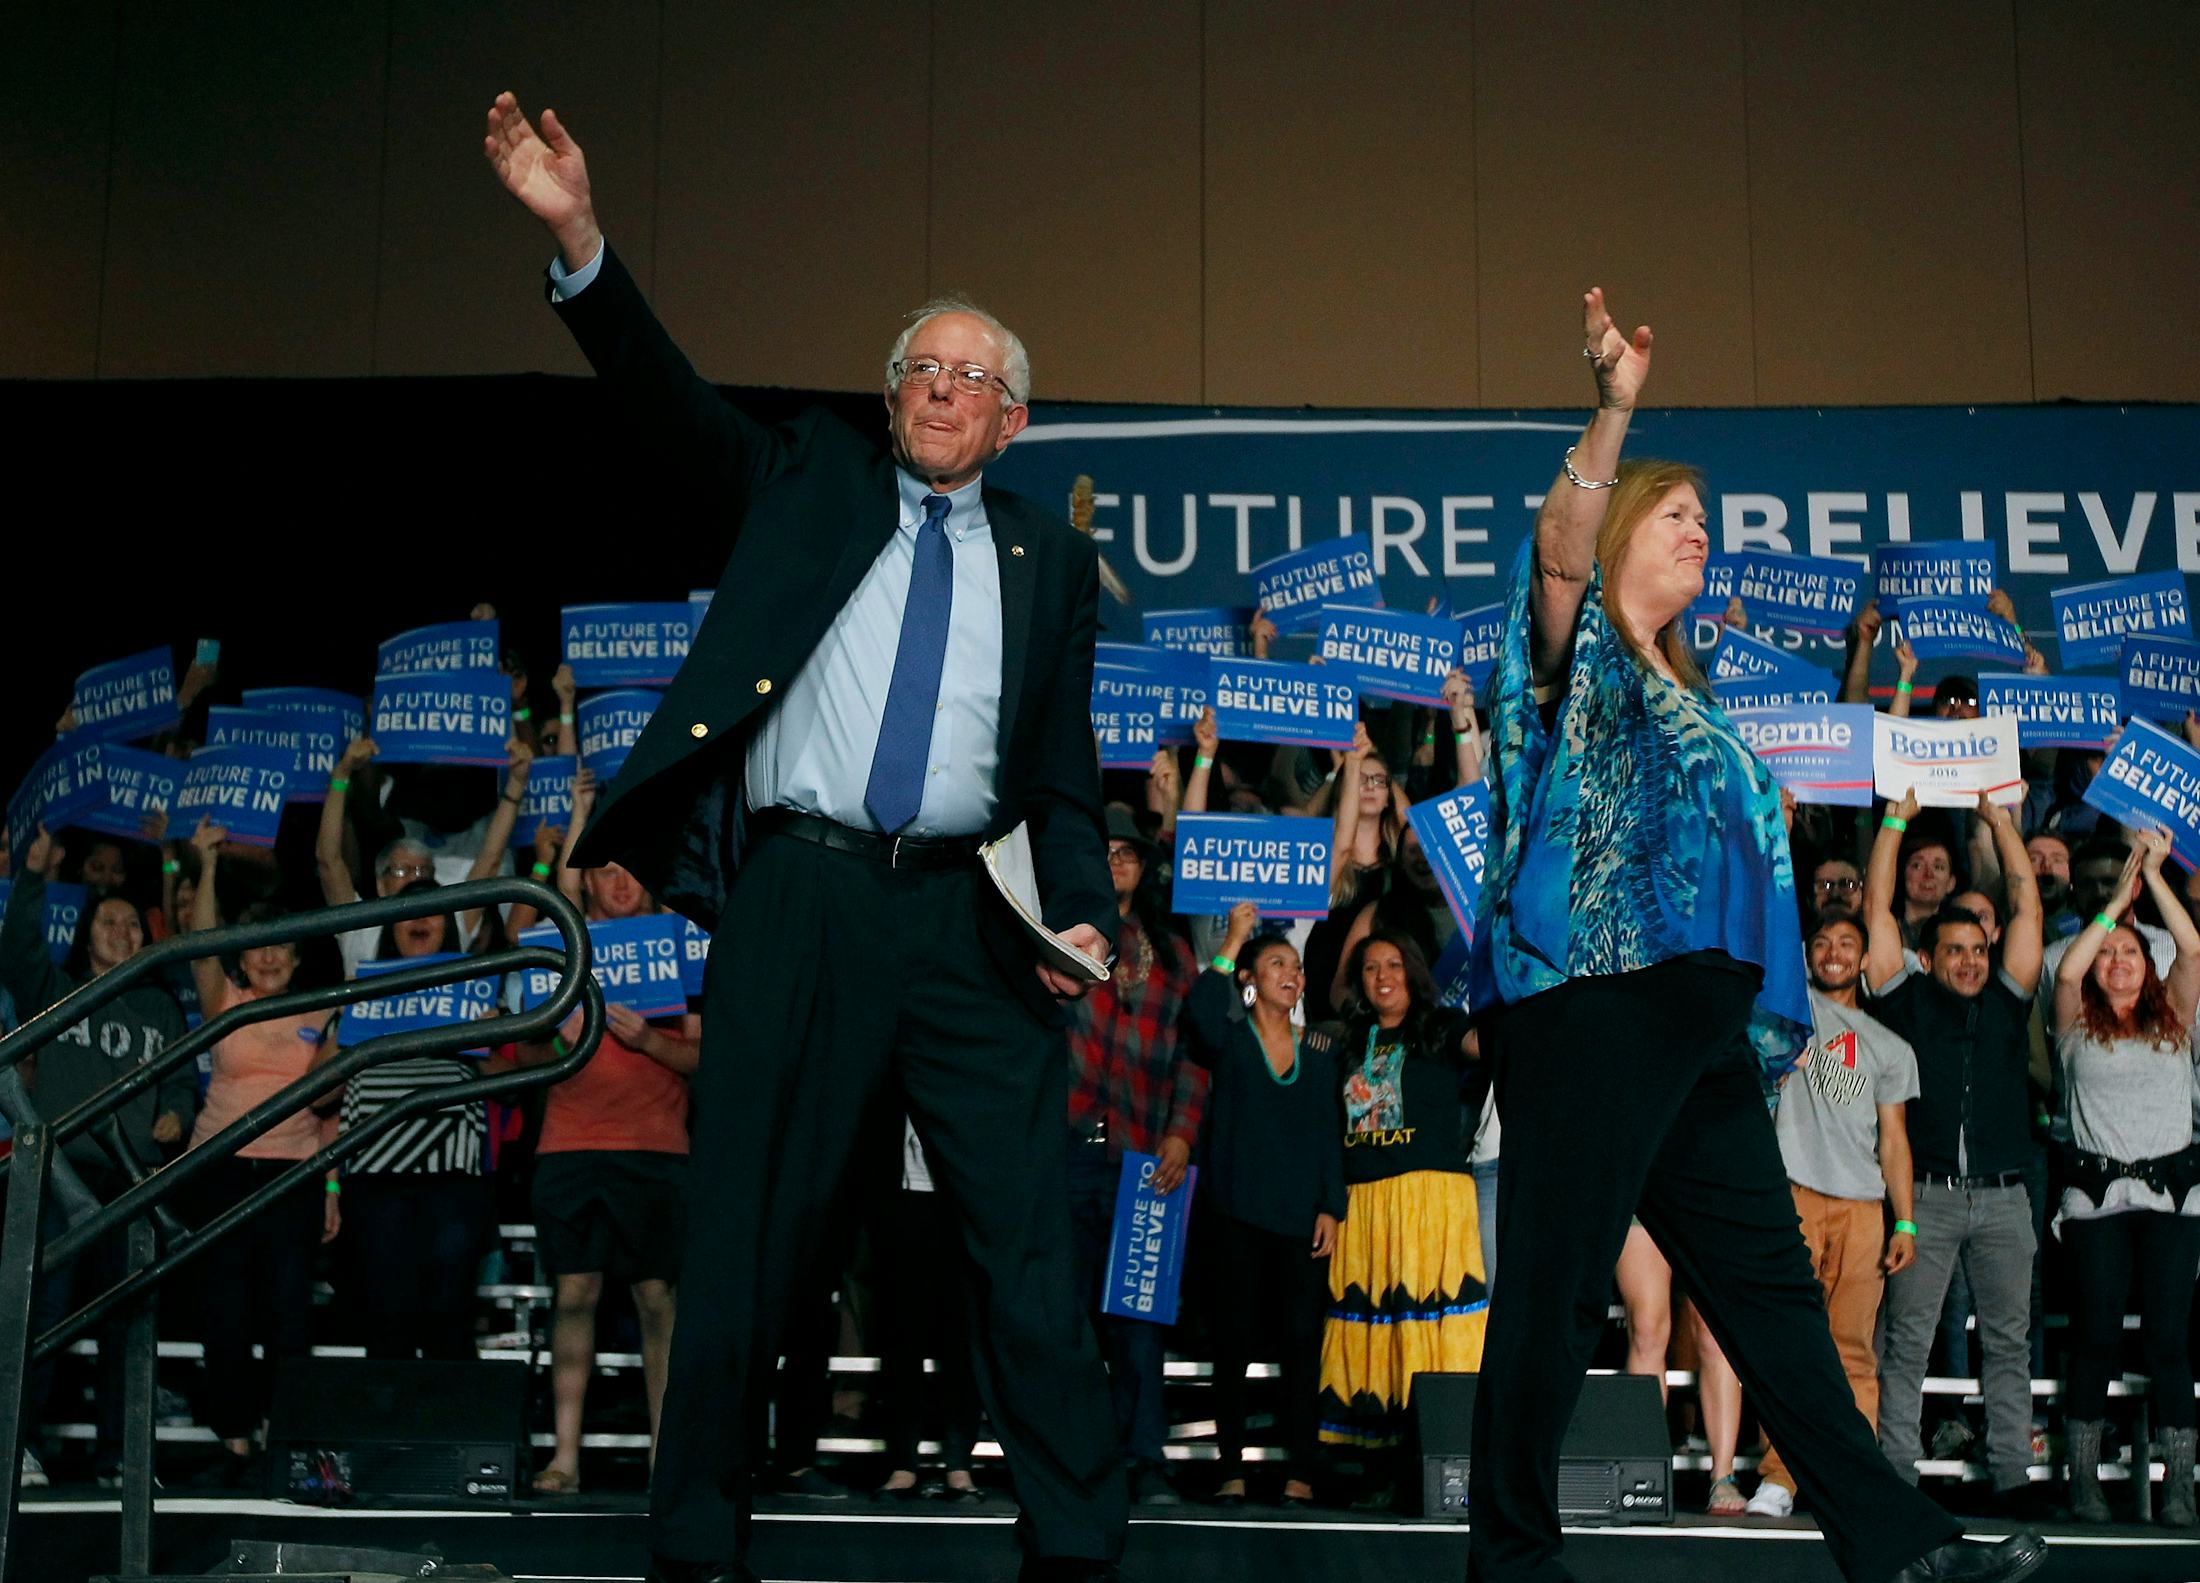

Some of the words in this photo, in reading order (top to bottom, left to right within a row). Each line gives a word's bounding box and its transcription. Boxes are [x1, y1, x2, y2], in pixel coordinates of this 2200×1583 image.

[1259, 581, 1269, 595] A
[1271, 559, 1340, 591] FUTURE
[1342, 552, 1368, 570] TO
[1709, 567, 1733, 581] TO
[1744, 563, 1755, 579] A
[1760, 566, 1828, 592] FUTURE
[1833, 576, 1856, 594] TO
[1880, 560, 1889, 576] A
[1893, 559, 1961, 577] FUTURE
[1966, 558, 1992, 576] TO
[1259, 574, 1345, 612] BELIEVE
[1349, 568, 1375, 590] IN
[1708, 581, 1732, 597] IN
[1740, 579, 1827, 610] BELIEVE
[1830, 595, 1854, 613] IN
[1879, 577, 1963, 596] BELIEVE
[1969, 576, 1992, 595] IN
[2063, 606, 2074, 623] A
[2078, 593, 2152, 620] FUTURE
[2155, 588, 2182, 607] TO
[1907, 610, 1920, 625] A
[1924, 608, 1992, 628] FUTURE
[2063, 610, 2155, 643] BELIEVE
[2161, 606, 2186, 627] IN
[568, 625, 580, 639] A
[584, 623, 657, 639] FUTURE
[662, 622, 688, 637] TO
[1151, 629, 1162, 641] A
[1167, 625, 1233, 642] FUTURE
[1326, 623, 1339, 638] A
[1344, 624, 1422, 651] FUTURE
[1427, 637, 1454, 657] TO
[1463, 629, 1474, 644] A
[1908, 621, 1998, 643] BELIEVE
[383, 656, 391, 669] A
[395, 638, 462, 664] FUTURE
[468, 637, 494, 650] TO
[568, 640, 658, 659] BELIEVE
[665, 640, 689, 657] IN
[1164, 642, 1235, 656] IEVE
[1323, 640, 1420, 673] BELIEVE
[1426, 657, 1451, 678] IN
[1722, 644, 1734, 661] A
[1738, 650, 1779, 675] FUT
[392, 653, 463, 673] IEVE
[469, 652, 494, 668] IN
[2132, 651, 2143, 668] A
[2150, 653, 2200, 676] FUTU
[73, 692, 81, 705] A
[84, 672, 144, 702] FUTURE
[150, 667, 170, 685] TO
[1180, 687, 1207, 701] TO
[1218, 673, 1232, 687] A
[1237, 674, 1318, 697] FUTURE
[1323, 684, 1353, 701] TO
[2128, 668, 2200, 697] BELIE
[72, 690, 148, 725] BELIEVE
[153, 685, 173, 704] IN
[378, 693, 390, 710] A
[396, 692, 474, 712] FUTURE
[479, 695, 506, 715] TO
[1217, 689, 1320, 718] BELIEVE
[1326, 701, 1353, 721] IN
[1722, 692, 1793, 710] UTURE
[1799, 691, 1829, 705] TO
[1987, 688, 1999, 704] A
[2005, 688, 2082, 706] FUTURE
[2088, 692, 2116, 709] TO
[342, 708, 362, 727] TO
[583, 720, 591, 736] A
[593, 710, 654, 731] FUTUR
[1126, 713, 1154, 727] TO
[1179, 703, 1204, 720] IN
[1986, 704, 2085, 724] BELIEVE
[2092, 707, 2117, 725] IN
[376, 711, 474, 734] BELIEVE
[480, 715, 506, 737] IN
[1737, 715, 1852, 748] Bernie
[214, 727, 226, 743] A
[231, 729, 300, 749] FUTURE
[306, 733, 334, 750] TO
[582, 728, 642, 757] BELIE
[1127, 728, 1154, 744] IN
[1888, 729, 1999, 760] Bernie
[74, 744, 100, 766] TO
[308, 753, 335, 772] IN
[78, 761, 103, 788] IN
[107, 765, 143, 786] URE
[149, 774, 173, 795] TO
[184, 767, 193, 787] A
[194, 764, 252, 786] FUTURE
[259, 768, 285, 790] TO
[1929, 767, 1959, 778] 2016
[2121, 740, 2136, 760] A
[2140, 749, 2200, 802] FUTU
[525, 776, 577, 794] UTUR
[142, 791, 169, 812] IN
[177, 784, 248, 809] BELIEVE
[252, 789, 281, 814] IN
[518, 795, 574, 816] ELIEV
[1458, 794, 1475, 812] A
[1183, 837, 1198, 855] A
[1204, 837, 1290, 860] FUTURE
[1296, 842, 1326, 861] TO
[1437, 798, 1485, 885] BELIE
[1181, 859, 1290, 885] BELIEVE
[1297, 864, 1325, 886] IN
[50, 904, 78, 924] TO
[48, 923, 75, 946] IN
[685, 920, 698, 936] A
[593, 942, 638, 963] URE
[643, 938, 676, 958] TO
[464, 979, 492, 999] TO
[530, 961, 641, 995] BEEVE
[648, 960, 679, 982] IN
[352, 995, 453, 1020] BELIEVE
[460, 1000, 489, 1020] IN
[1372, 1128, 1417, 1146] FLAT
[1138, 1161, 1156, 1193] TO
[1124, 1198, 1149, 1288] FUTURE
[1136, 1200, 1166, 1313] BELIEVE
[1122, 1294, 1136, 1309] A
